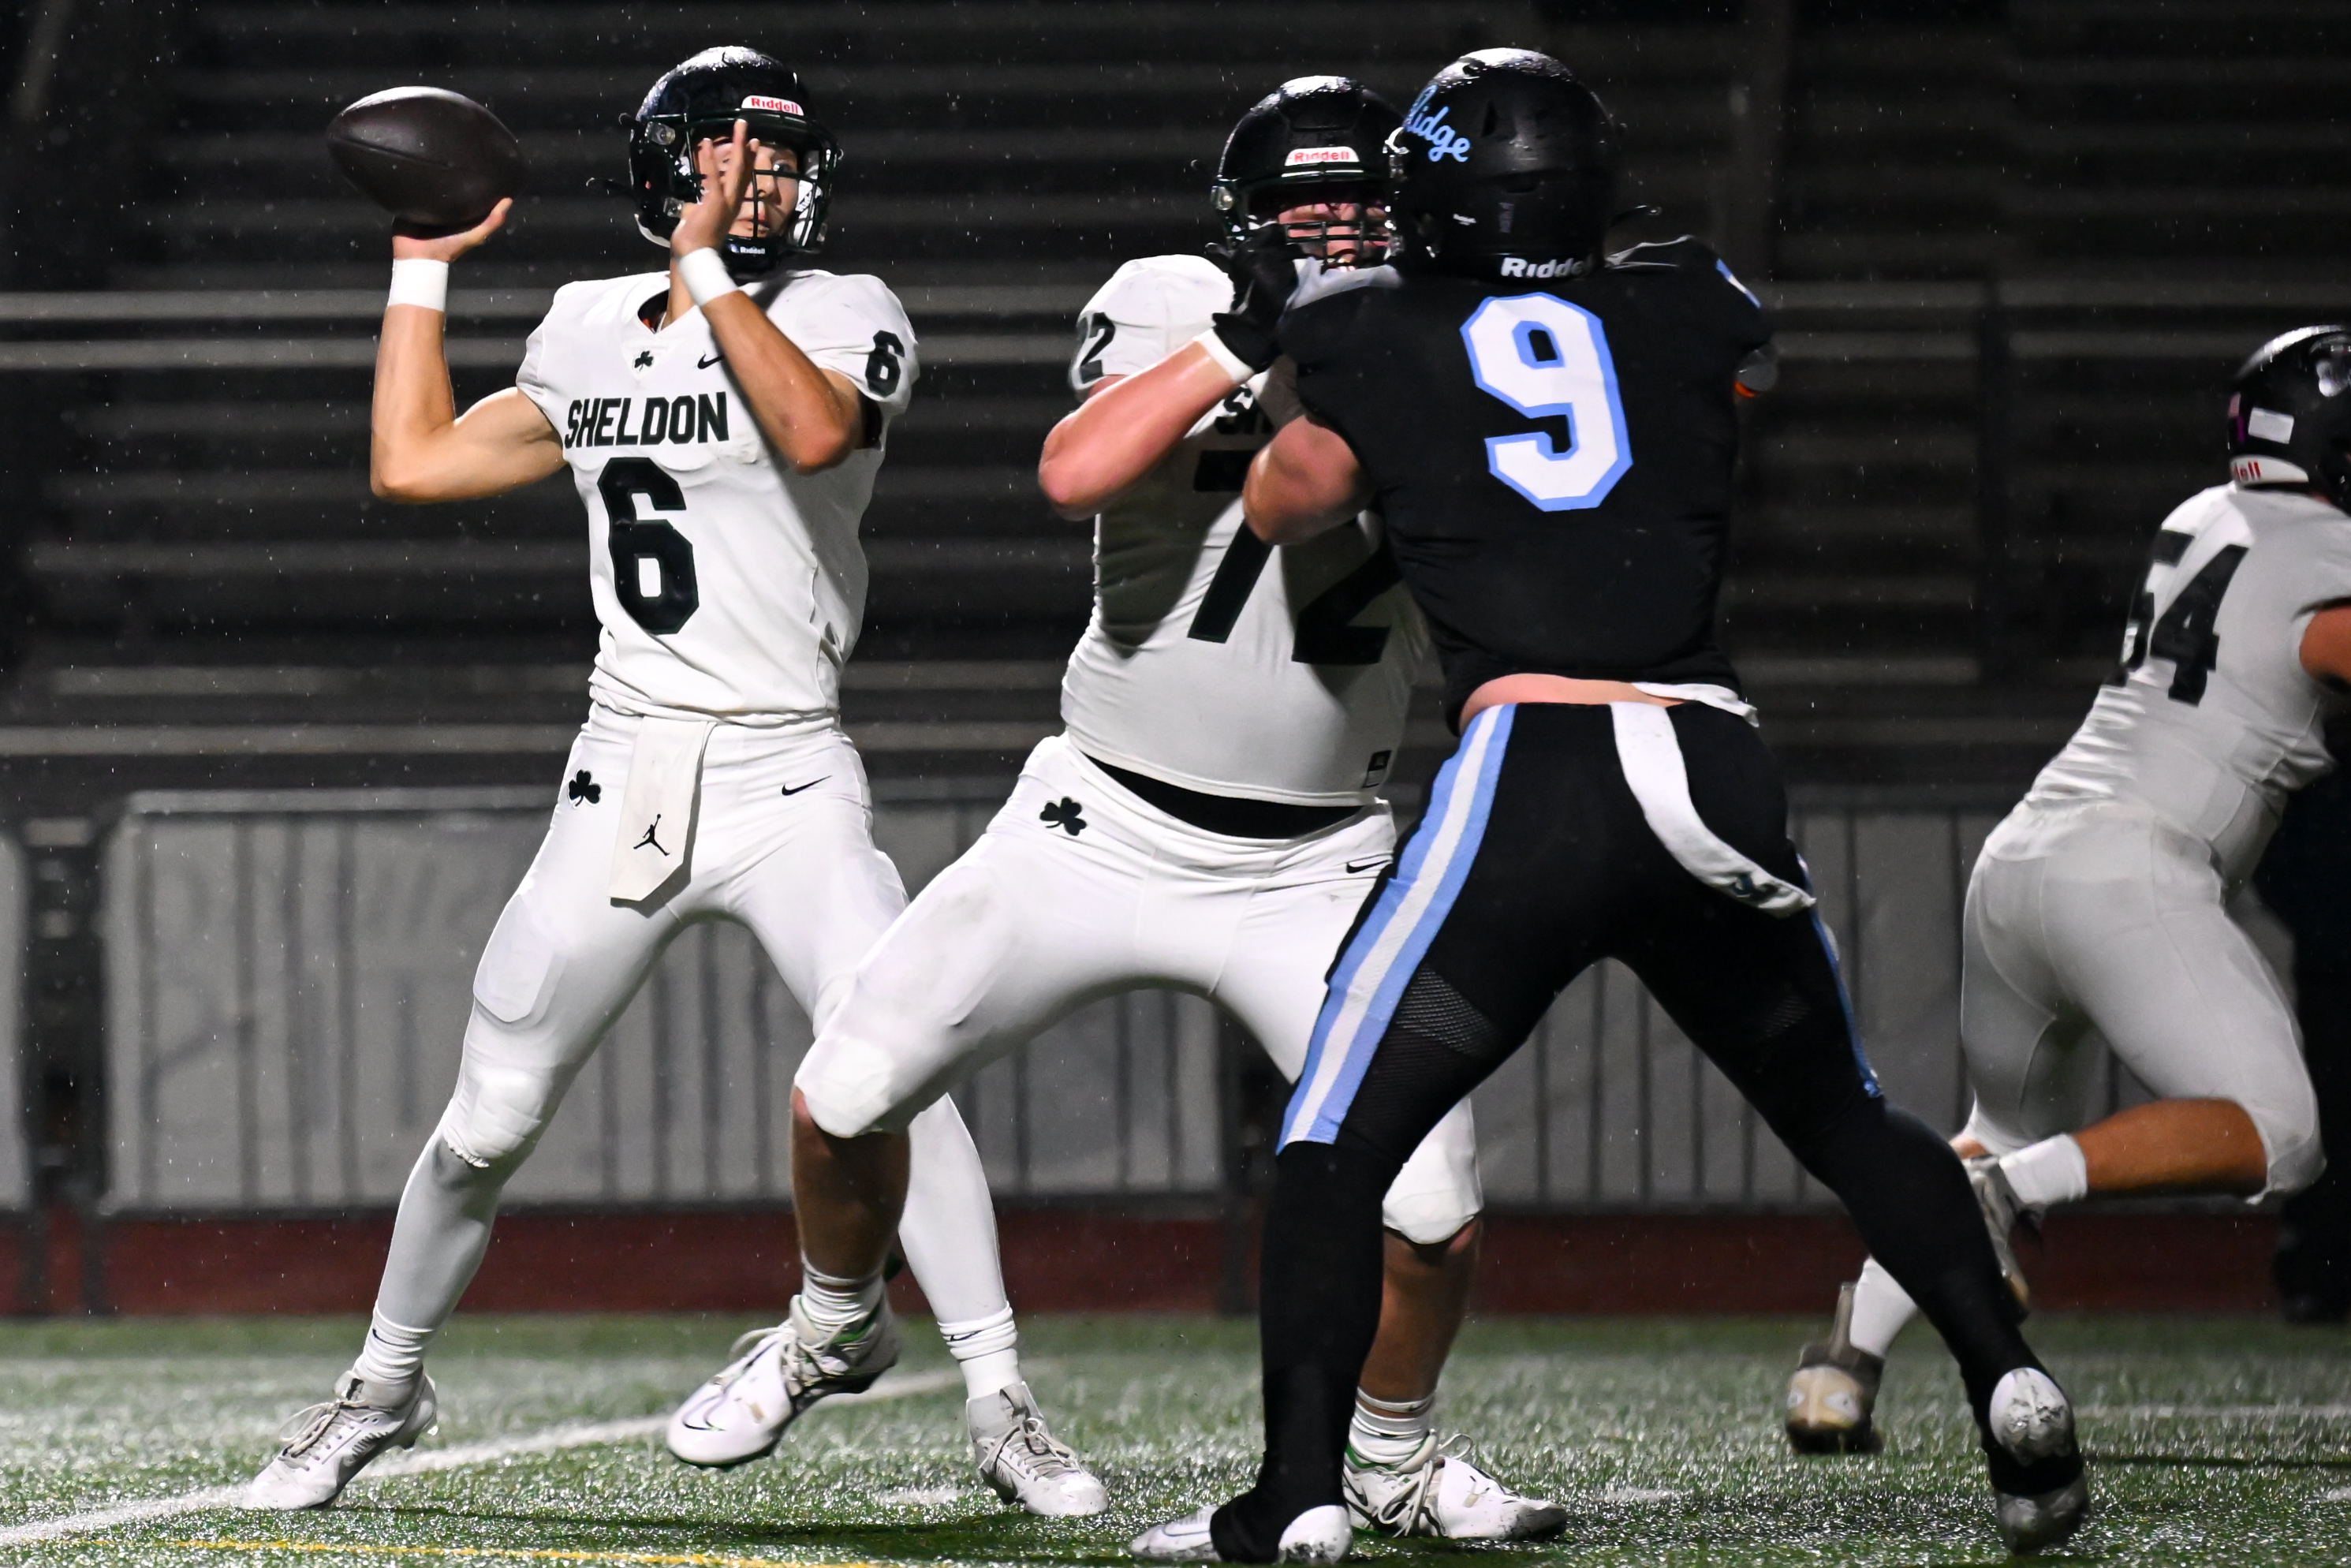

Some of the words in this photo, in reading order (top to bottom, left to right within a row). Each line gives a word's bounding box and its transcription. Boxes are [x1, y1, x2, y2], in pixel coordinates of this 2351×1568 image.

[751, 97, 799, 114] Riddell
[1294, 151, 1349, 163] Riddell
[864, 330, 905, 396] 6
[1077, 312, 1116, 385] 2
[564, 391, 730, 450] SHELDON
[1460, 292, 1633, 512] 9
[597, 456, 700, 635] 6
